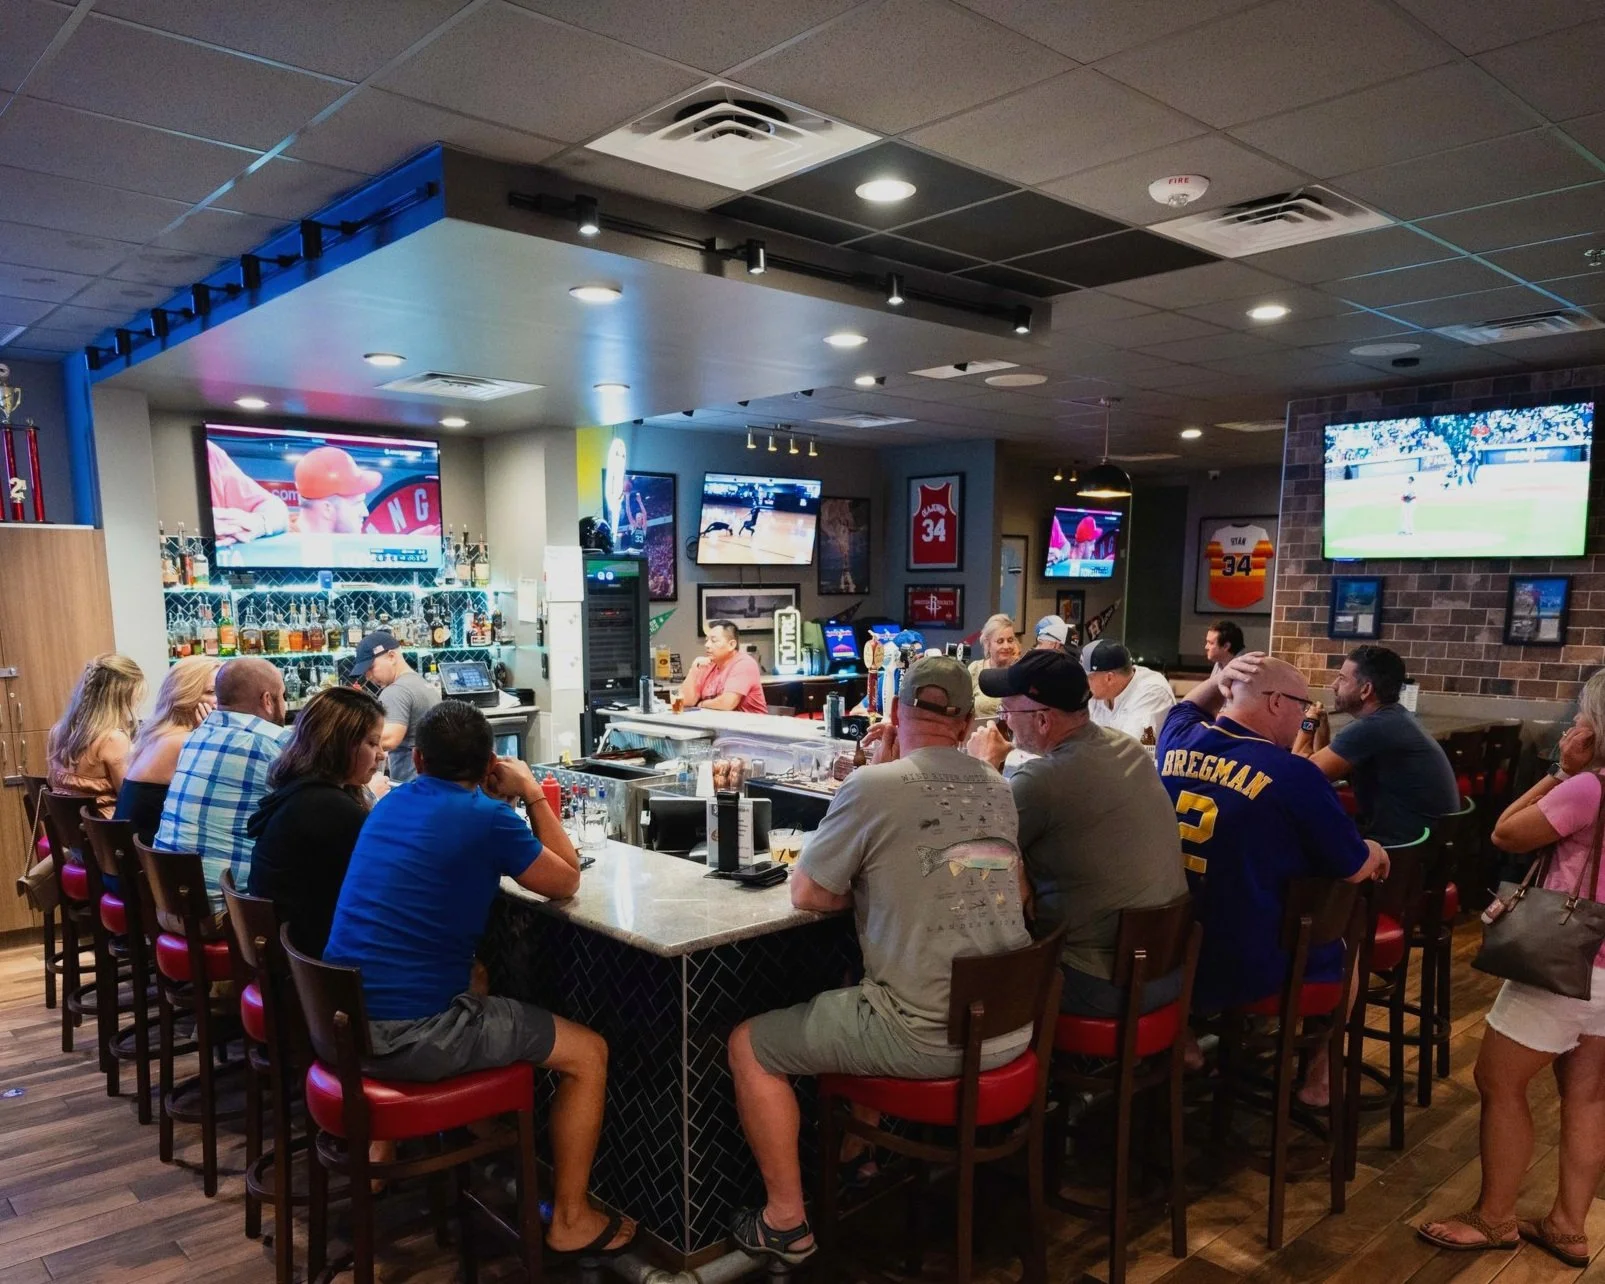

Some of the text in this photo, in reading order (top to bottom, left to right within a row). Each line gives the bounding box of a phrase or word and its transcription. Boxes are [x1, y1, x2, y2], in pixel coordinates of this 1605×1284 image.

[921, 518, 946, 542] 34
[1230, 537, 1246, 545] RYAN
[1222, 555, 1252, 576] 34
[901, 772, 929, 782] WIND
[1161, 749, 1273, 800] BREGMAN
[1176, 790, 1219, 873] 2
